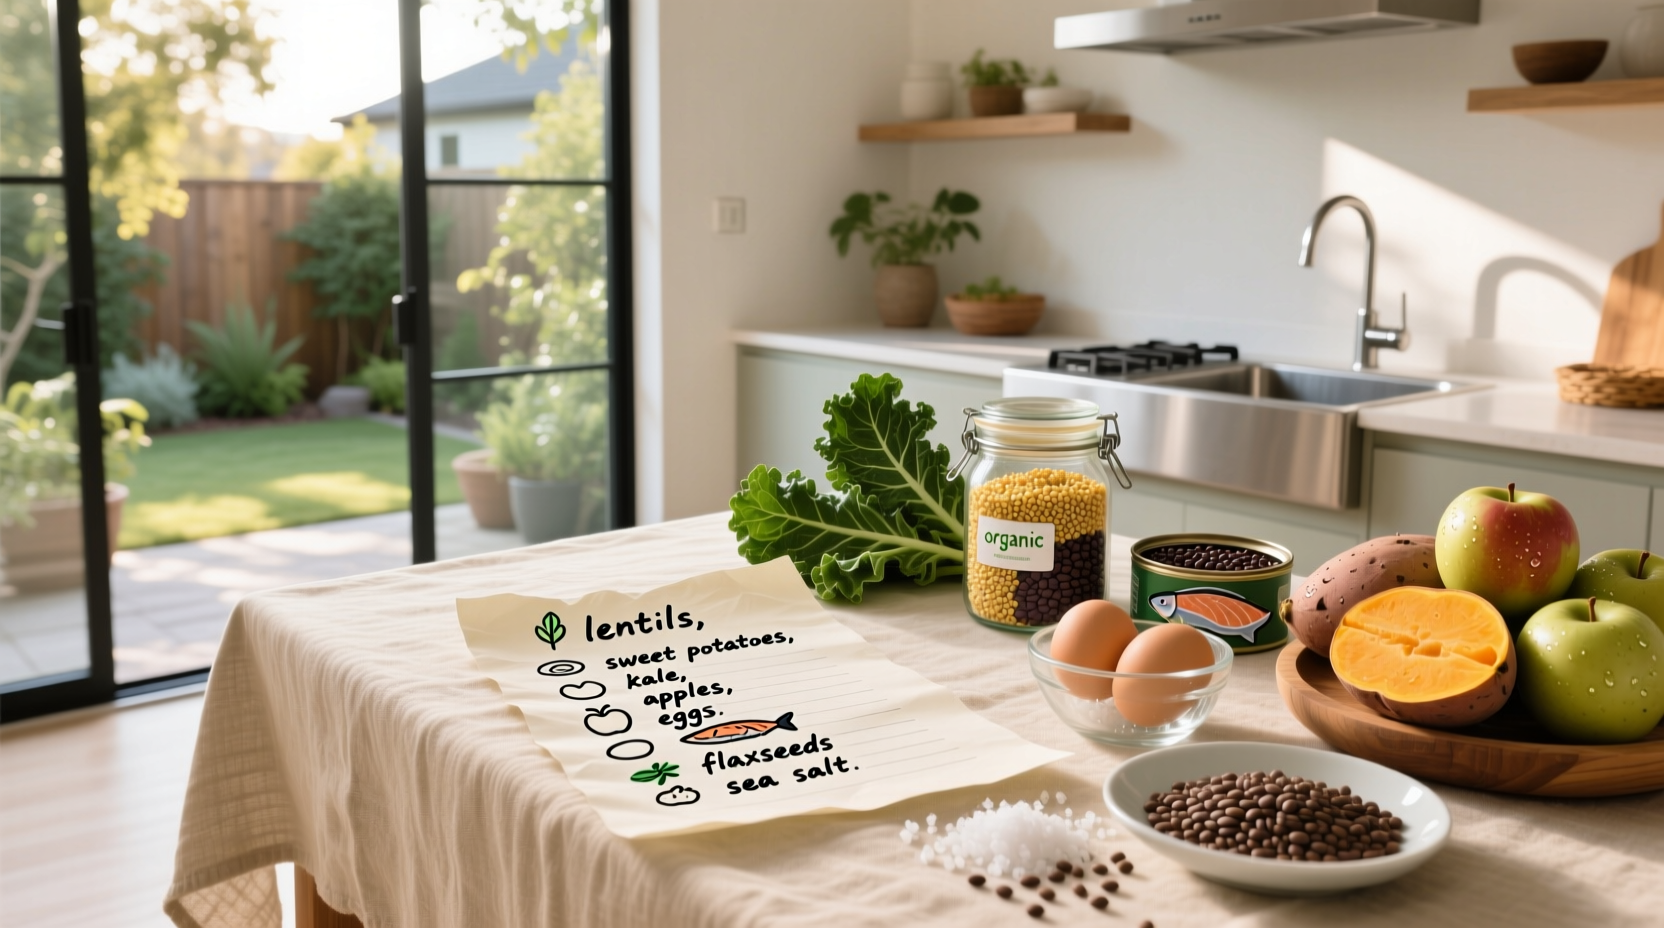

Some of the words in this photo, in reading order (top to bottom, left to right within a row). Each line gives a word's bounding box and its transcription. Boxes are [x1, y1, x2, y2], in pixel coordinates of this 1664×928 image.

[984, 531, 1044, 552] organic
[584, 604, 705, 642] lentils,
[605, 645, 677, 670] sweet
[687, 631, 794, 662] potatoes,
[626, 667, 687, 690] kale,
[643, 681, 733, 709] apples,
[658, 704, 724, 730] eggs.
[701, 733, 834, 776] flaxseeds
[726, 773, 779, 795] sea
[792, 755, 860, 783] salt.
